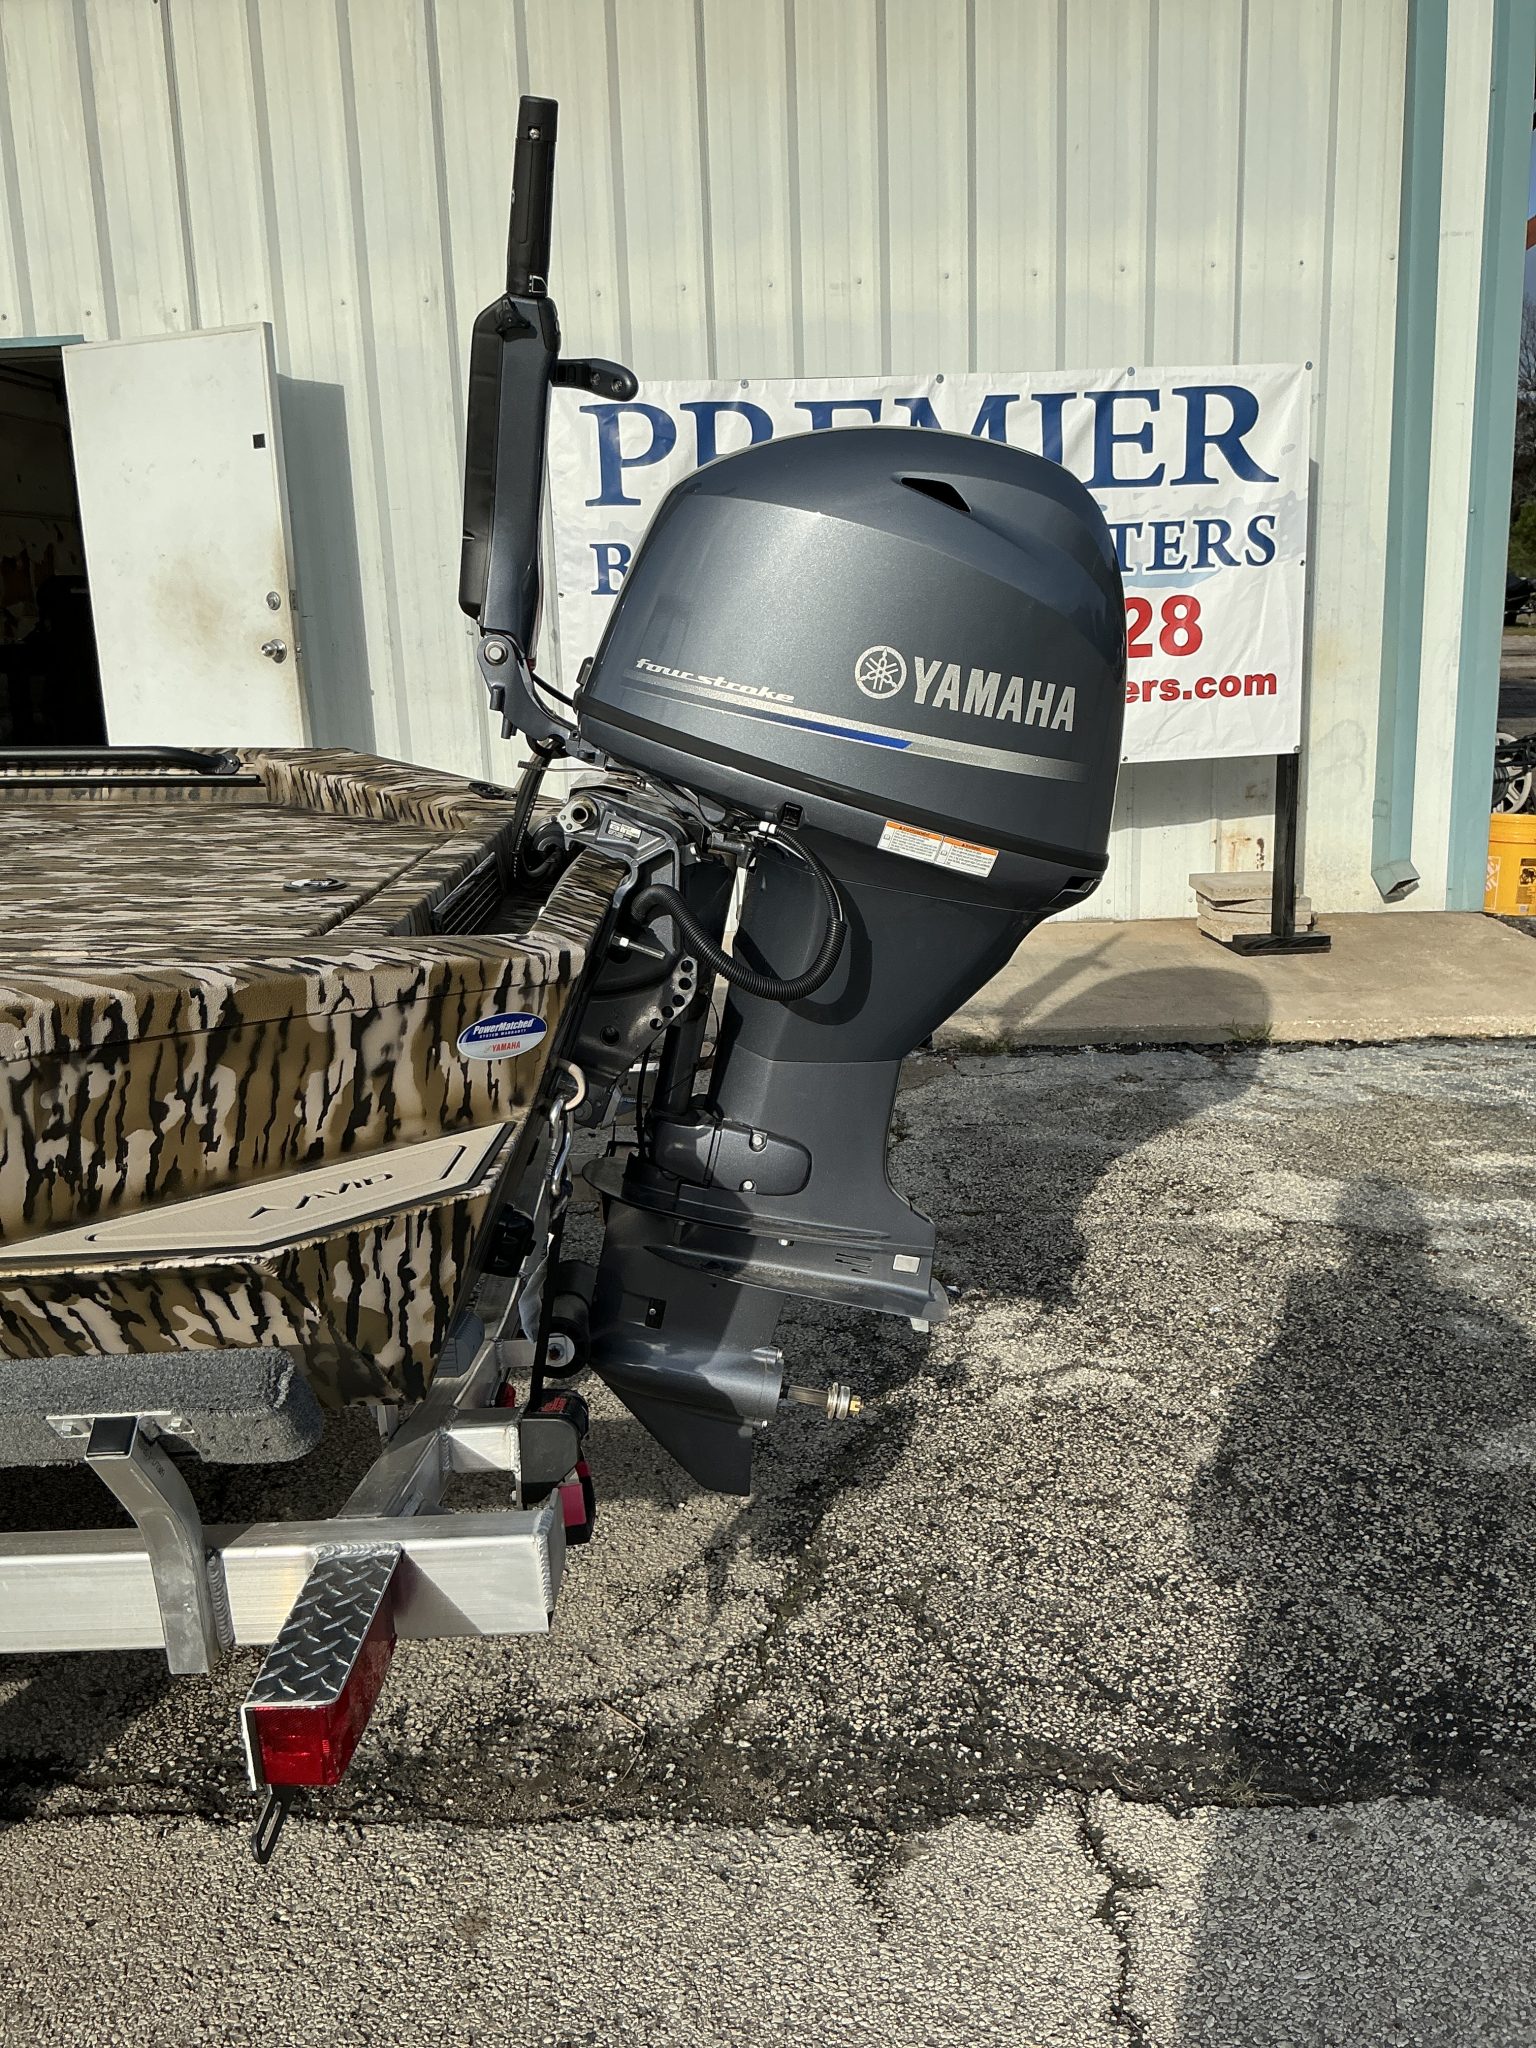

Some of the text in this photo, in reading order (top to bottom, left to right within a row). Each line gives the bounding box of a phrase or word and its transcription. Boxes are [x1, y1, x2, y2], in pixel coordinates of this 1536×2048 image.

[635, 658, 795, 703] four stroke
[914, 656, 1077, 732] YAMAHA
[472, 1018, 535, 1036] PowerMatched
[491, 1041, 521, 1053] YAMAHA
[295, 1173, 393, 1210] AVID
